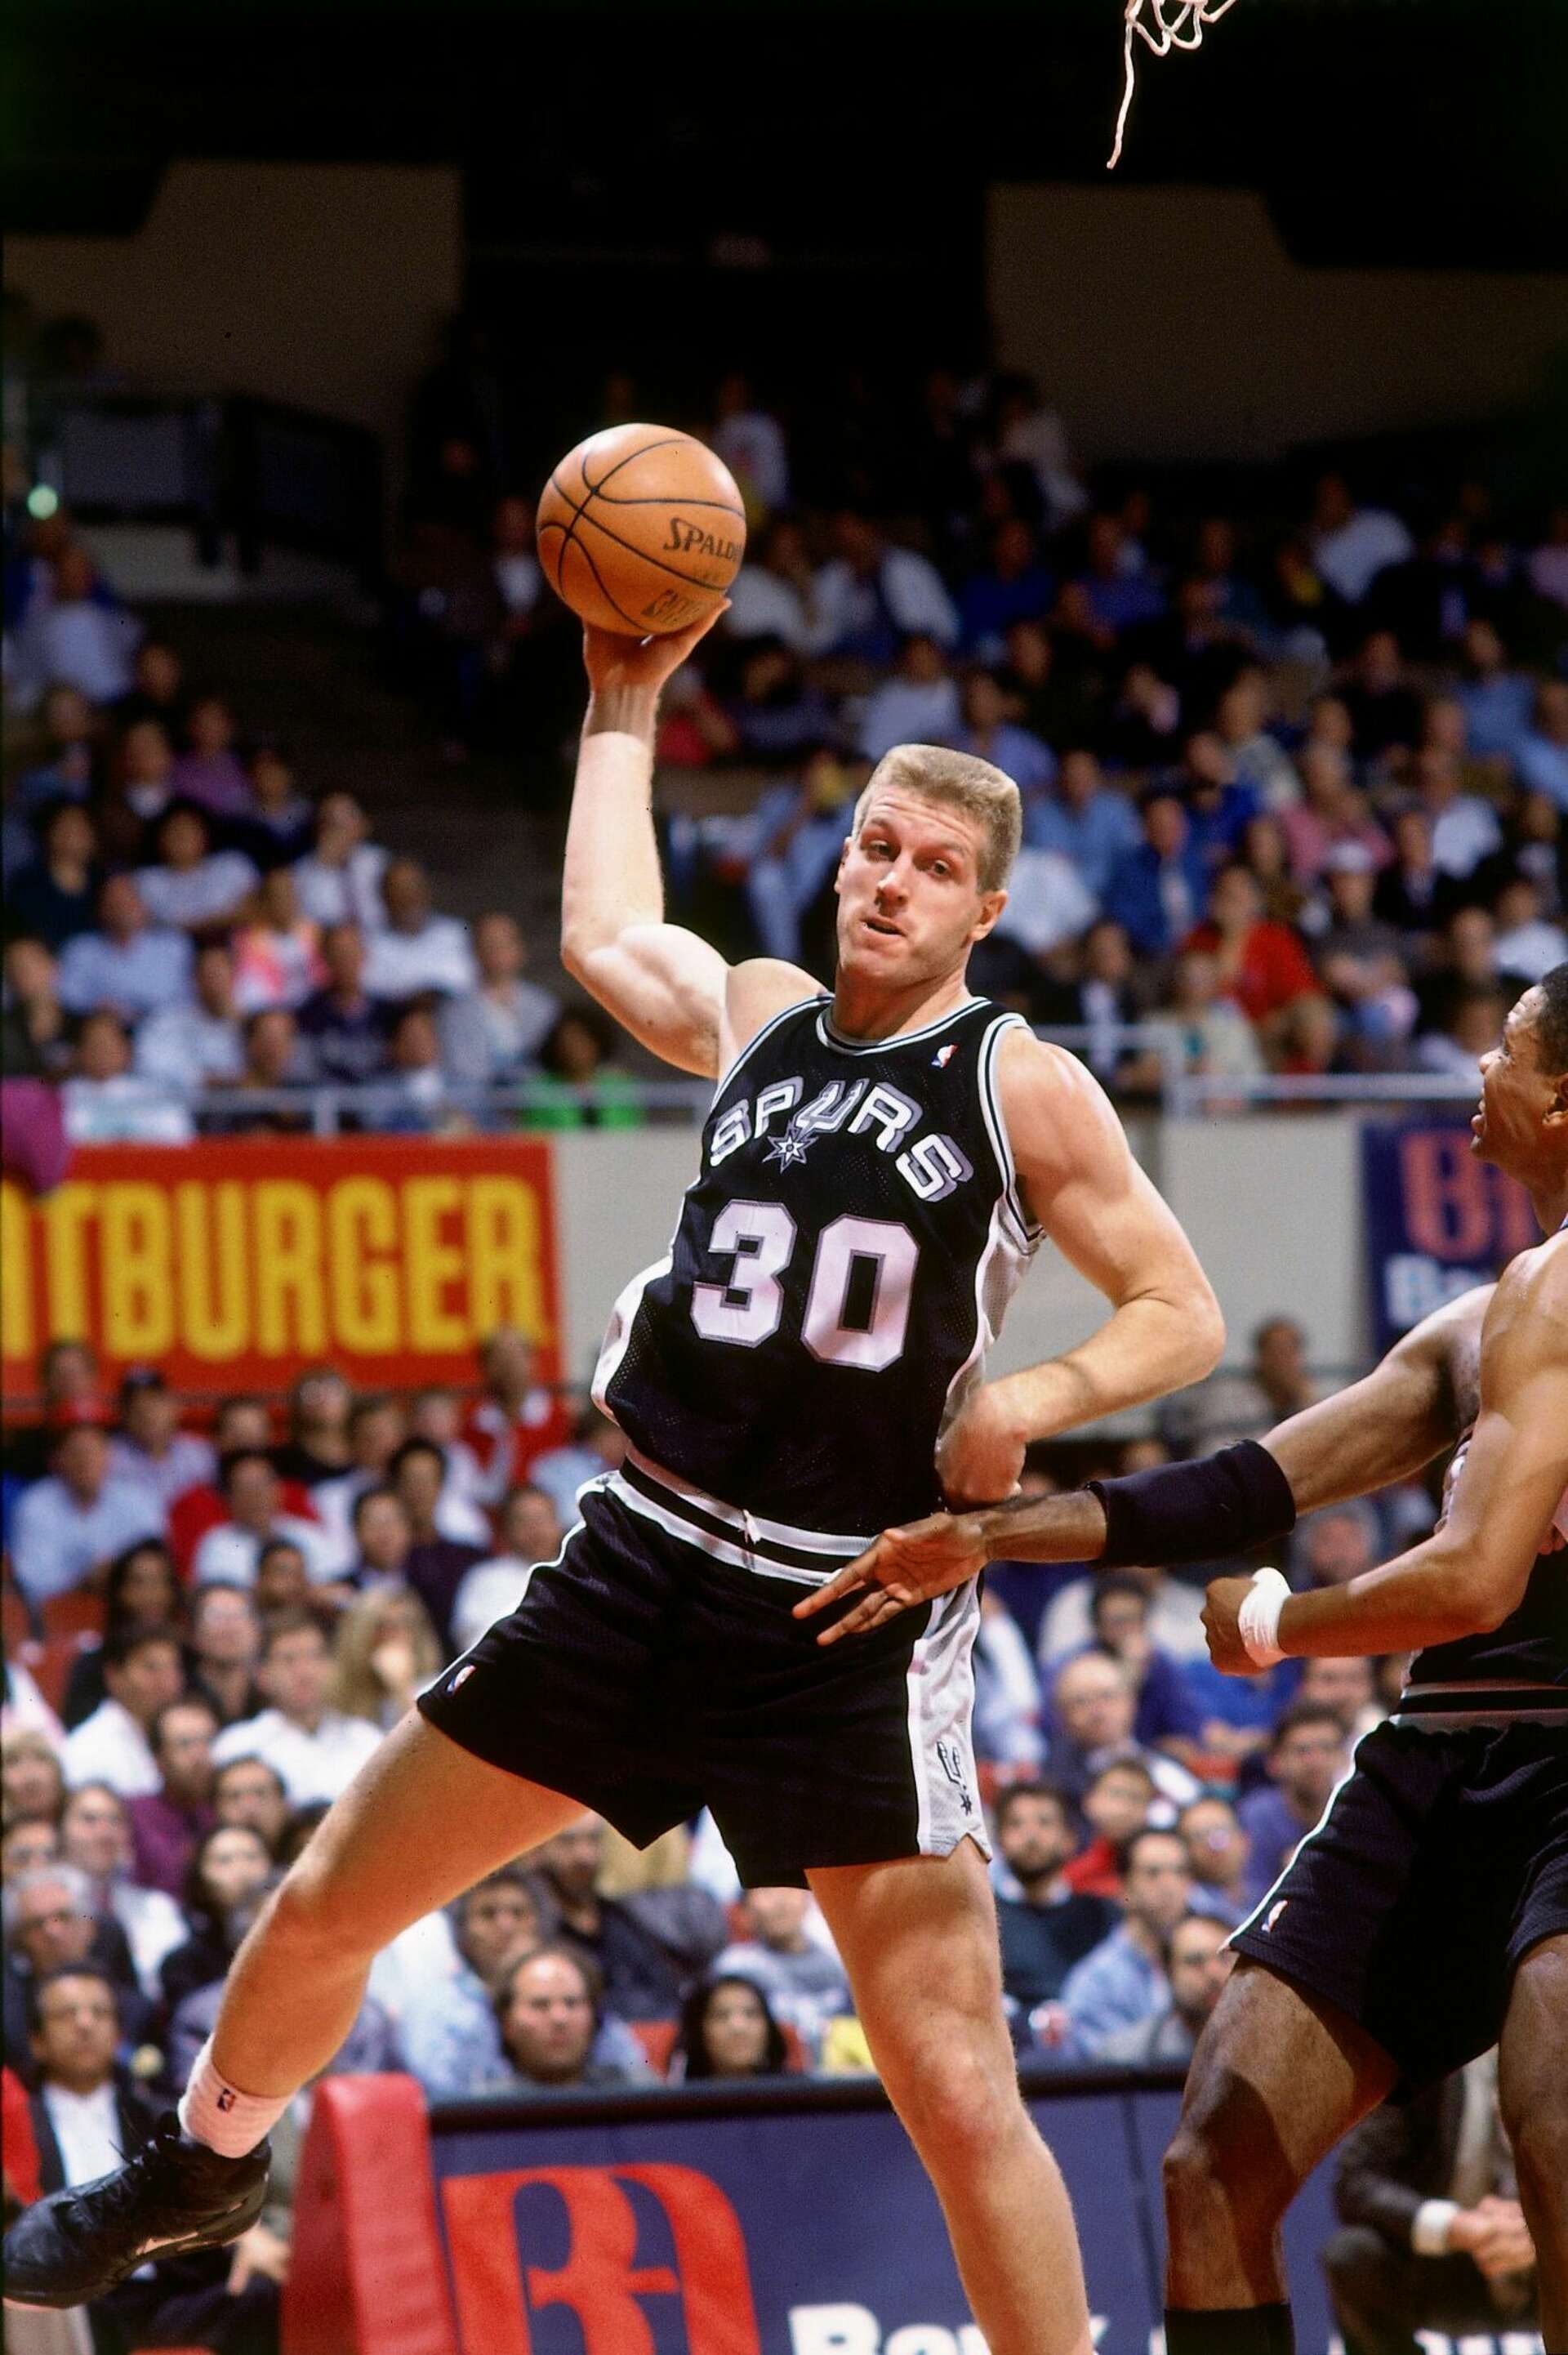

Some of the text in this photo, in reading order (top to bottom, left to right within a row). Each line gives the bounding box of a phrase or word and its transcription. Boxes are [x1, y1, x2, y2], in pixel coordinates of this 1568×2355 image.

[662, 517, 744, 562] SPALD
[709, 1075, 973, 1203] SPURS
[690, 1198, 921, 1373] 30
